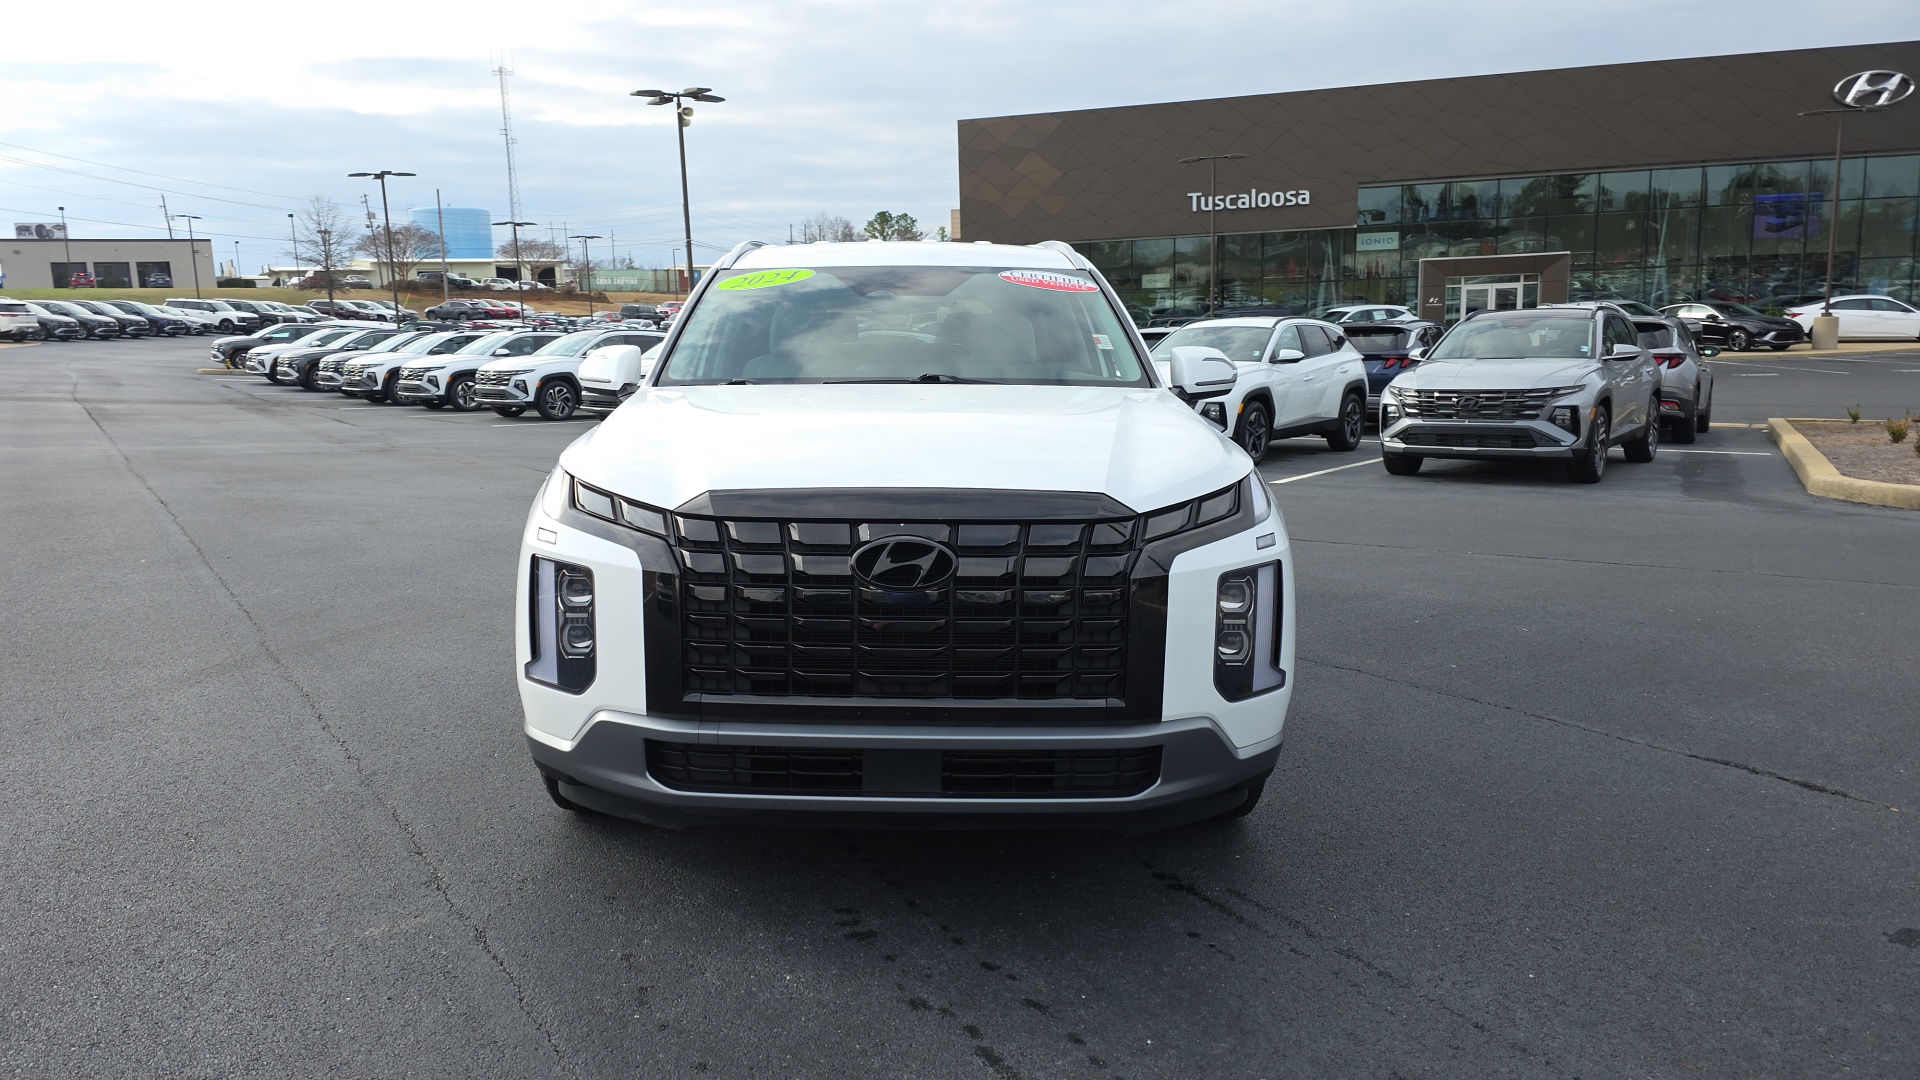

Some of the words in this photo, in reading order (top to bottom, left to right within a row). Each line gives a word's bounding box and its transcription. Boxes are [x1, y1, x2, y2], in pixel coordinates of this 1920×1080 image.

[1187, 188, 1310, 212] Tuscaloosa
[613, 276, 638, 285] SHIPPING
[730, 270, 800, 289] 2024
[1009, 270, 1087, 286] CERTIFIED
[1010, 276, 1039, 284] USED
[1043, 280, 1089, 291] VEHICLE
